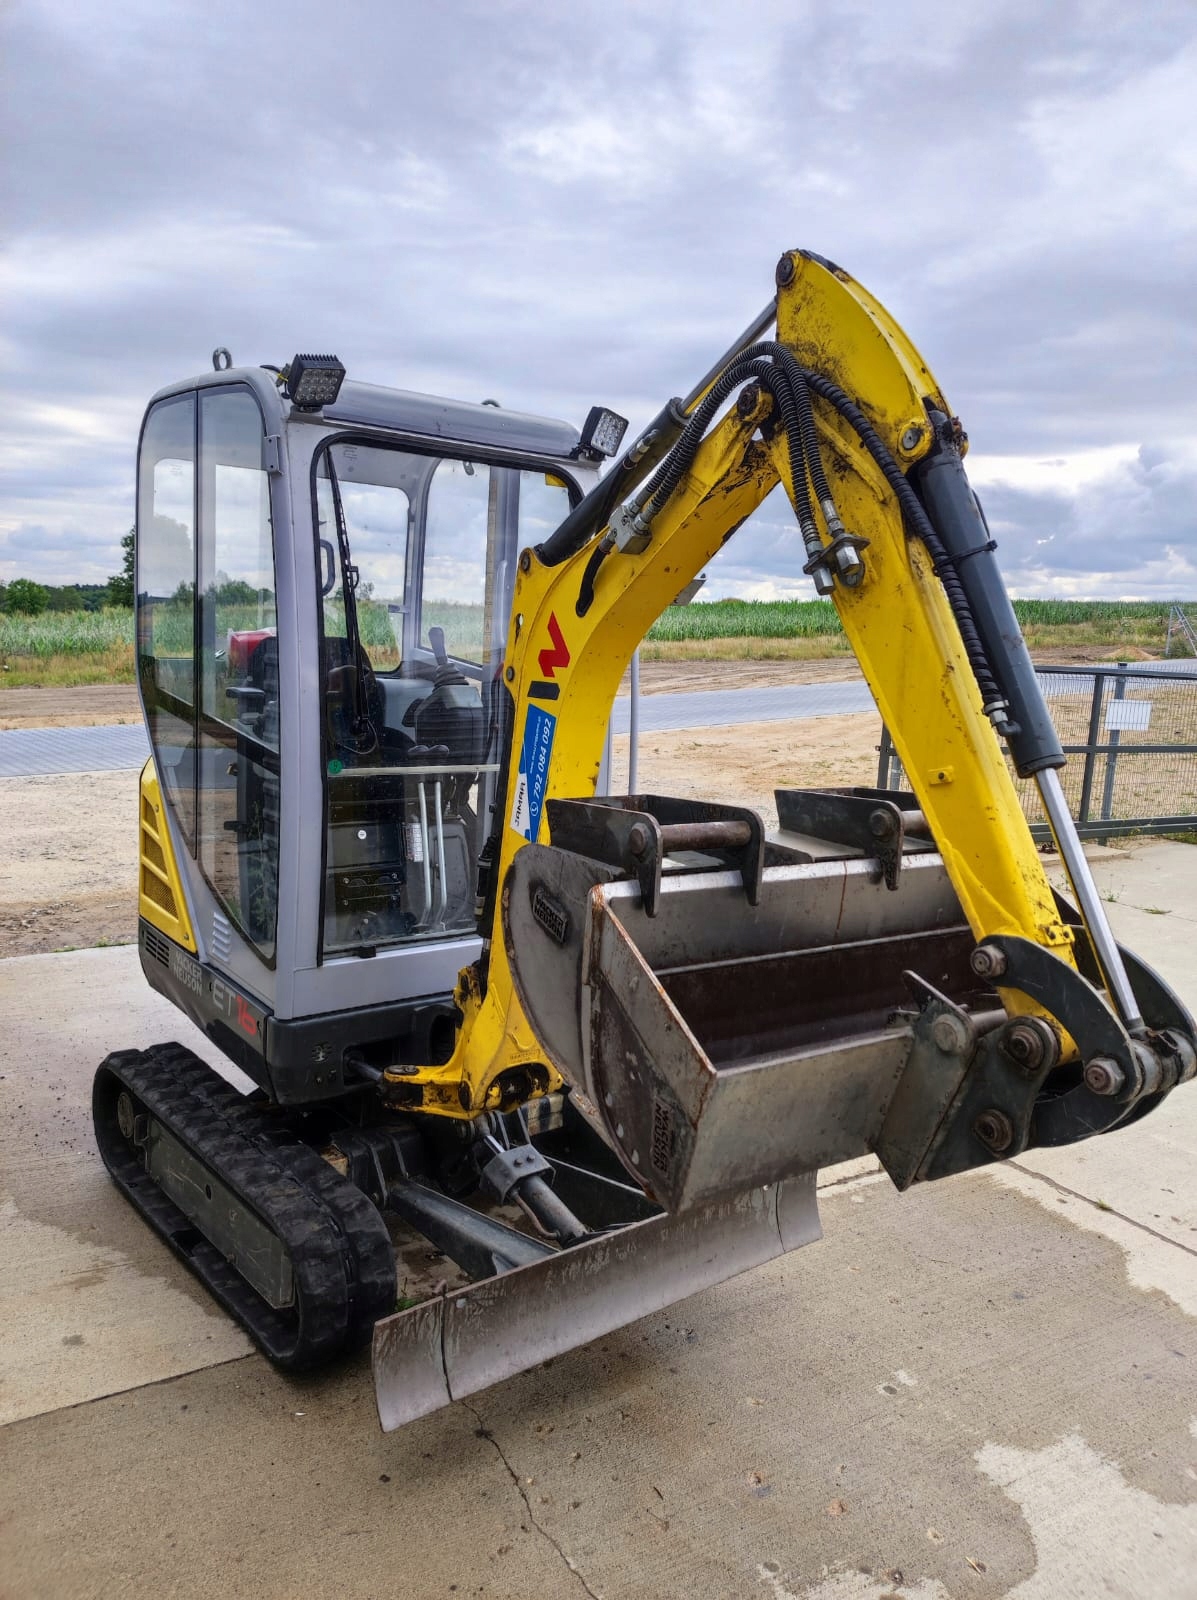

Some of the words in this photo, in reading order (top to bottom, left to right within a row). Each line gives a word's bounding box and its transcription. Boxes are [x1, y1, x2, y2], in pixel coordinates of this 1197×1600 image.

[541, 718, 552, 744] 092
[537, 747, 547, 772] 084
[533, 775, 543, 800] 792
[173, 963, 203, 996] NEUSON
[175, 951, 203, 982] WACKER
